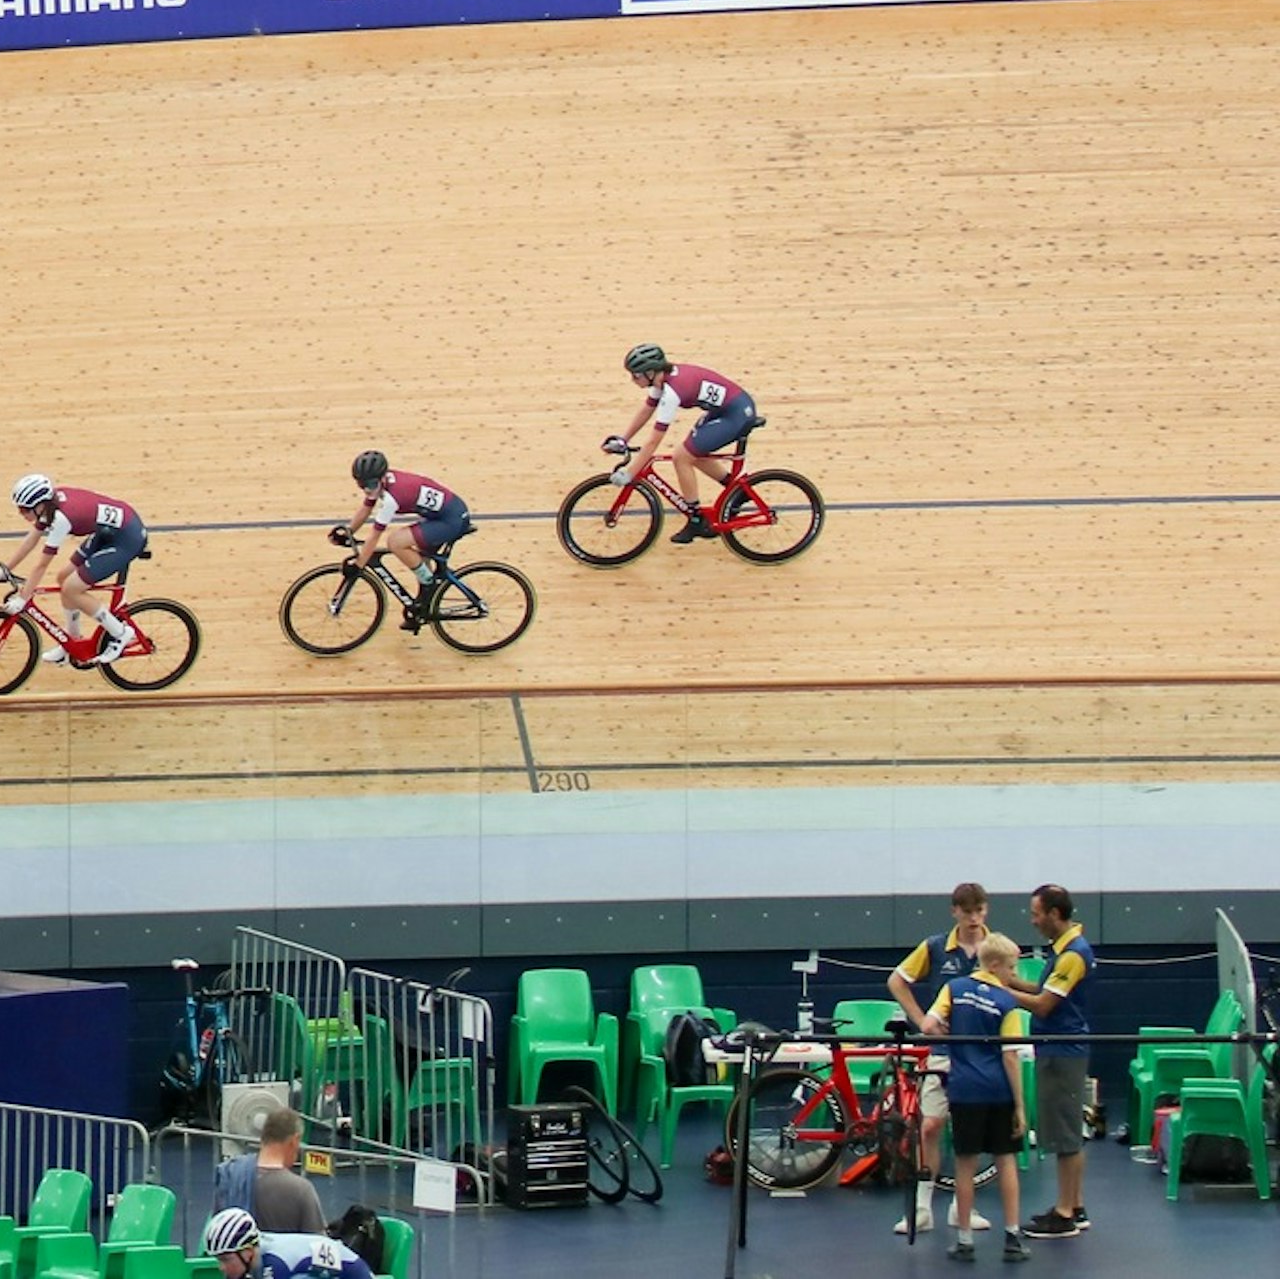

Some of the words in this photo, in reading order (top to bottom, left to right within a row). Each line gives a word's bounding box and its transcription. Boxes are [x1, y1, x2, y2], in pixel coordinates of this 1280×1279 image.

[425, 489, 439, 507] 95
[104, 507, 118, 523] 92
[538, 772, 590, 792] 200
[309, 1152, 328, 1167] TFH
[318, 1243, 336, 1266] 46
